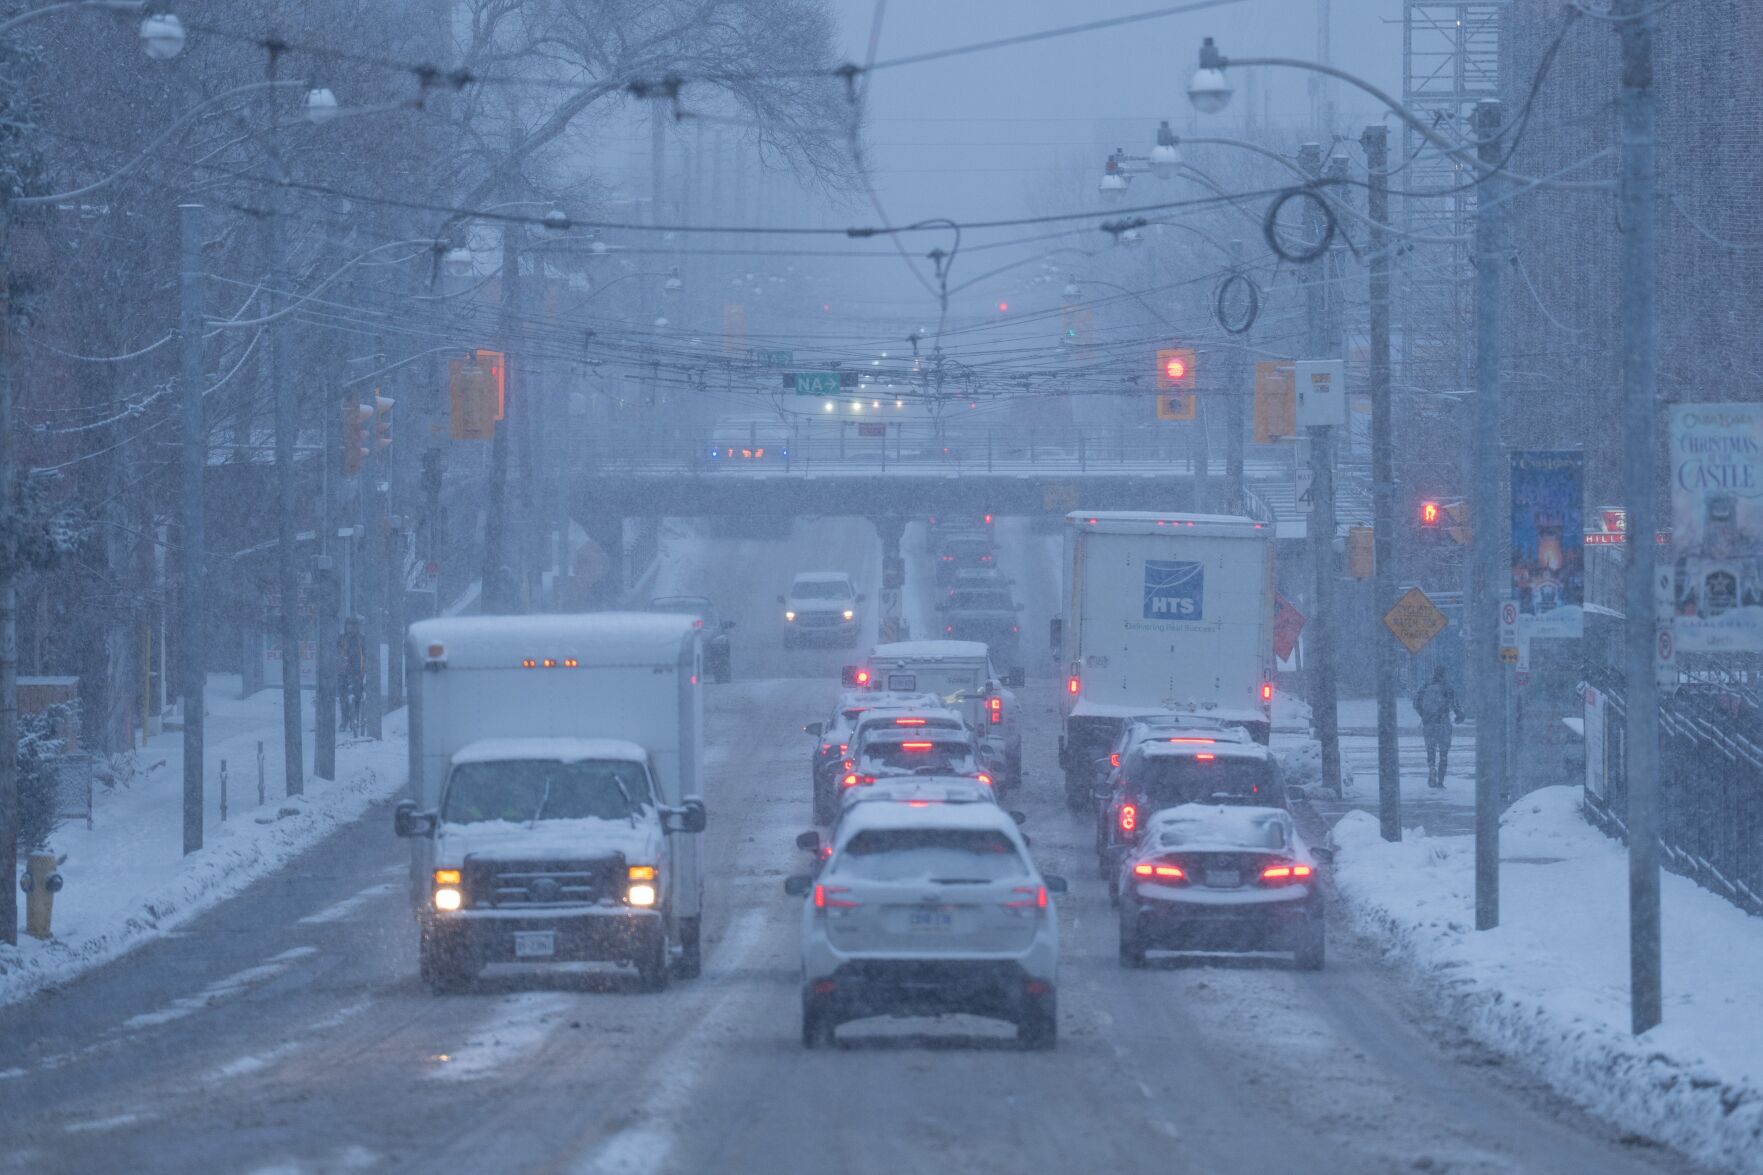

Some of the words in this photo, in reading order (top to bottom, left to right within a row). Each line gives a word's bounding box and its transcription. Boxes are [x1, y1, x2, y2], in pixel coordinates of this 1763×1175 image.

[798, 377, 824, 392] NA
[1680, 433, 1759, 454] CHRISTMAS
[1678, 459, 1755, 493] CASTLE
[1152, 597, 1195, 614] HTS
